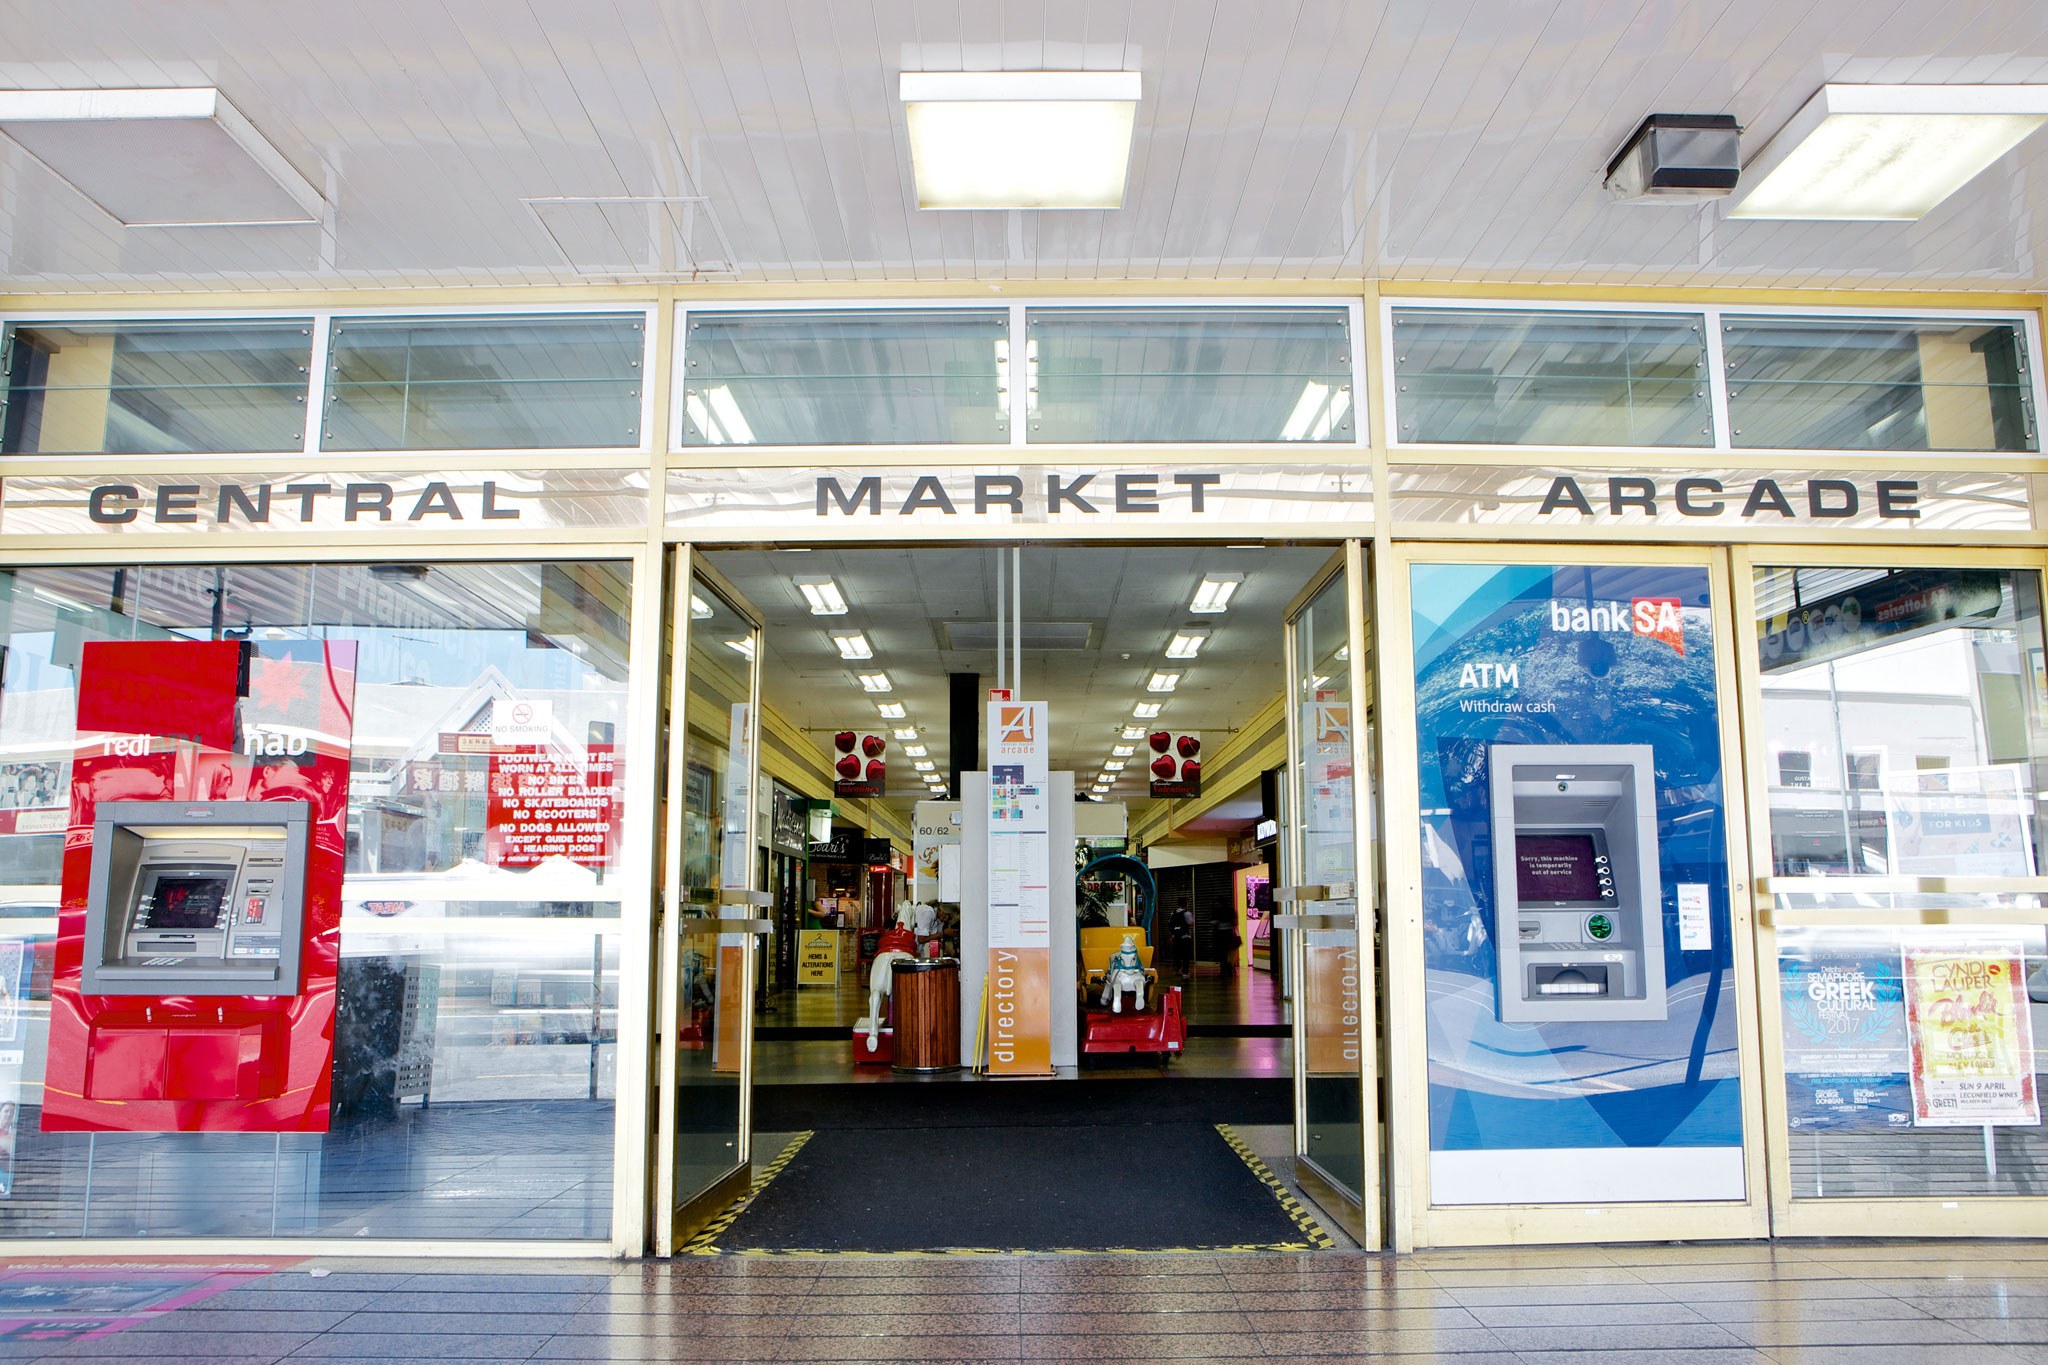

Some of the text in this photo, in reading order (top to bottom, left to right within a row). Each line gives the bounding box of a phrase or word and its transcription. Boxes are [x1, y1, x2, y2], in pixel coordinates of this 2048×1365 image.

[89, 474, 1921, 524] CENTRAL MARKET ARCADE
[1552, 601, 1631, 632] bank
[1459, 663, 1519, 688] ATM
[1460, 699, 1556, 713] Withdraw cash
[495, 725, 549, 733] NO SMOKING
[243, 731, 308, 757] nab
[498, 753, 561, 763] FOOTWEAR
[599, 752, 615, 761] BE
[499, 764, 534, 773] WORN
[536, 764, 552, 773] AT
[554, 764, 575, 772] ALL
[528, 775, 585, 785] NO BIKES
[498, 786, 613, 796] NO ROLLER BLADES
[503, 798, 608, 808] NO SKATEBOARDS
[513, 809, 597, 819] NO SCOOTERS
[500, 823, 610, 833] NO DOGS ALLOWED
[919, 827, 949, 835] 60/62
[523, 845, 565, 853] HEARING
[1087, 882, 1123, 893] DRKS
[1932, 960, 1986, 978] CYNDI
[1808, 972, 1865, 982] SEMAPHORE
[1931, 975, 1996, 992] LAUPER
[1808, 981, 1876, 1001] GREEK
[994, 951, 1018, 1063] directory
[1817, 1000, 1877, 1011] CULTURAL
[1168, 1008, 1174, 1016] 5
[1819, 1010, 1851, 1020] FESTIVAL
[1827, 1018, 1860, 1034] 2017
[1933, 1098, 1958, 1108] GREEN
